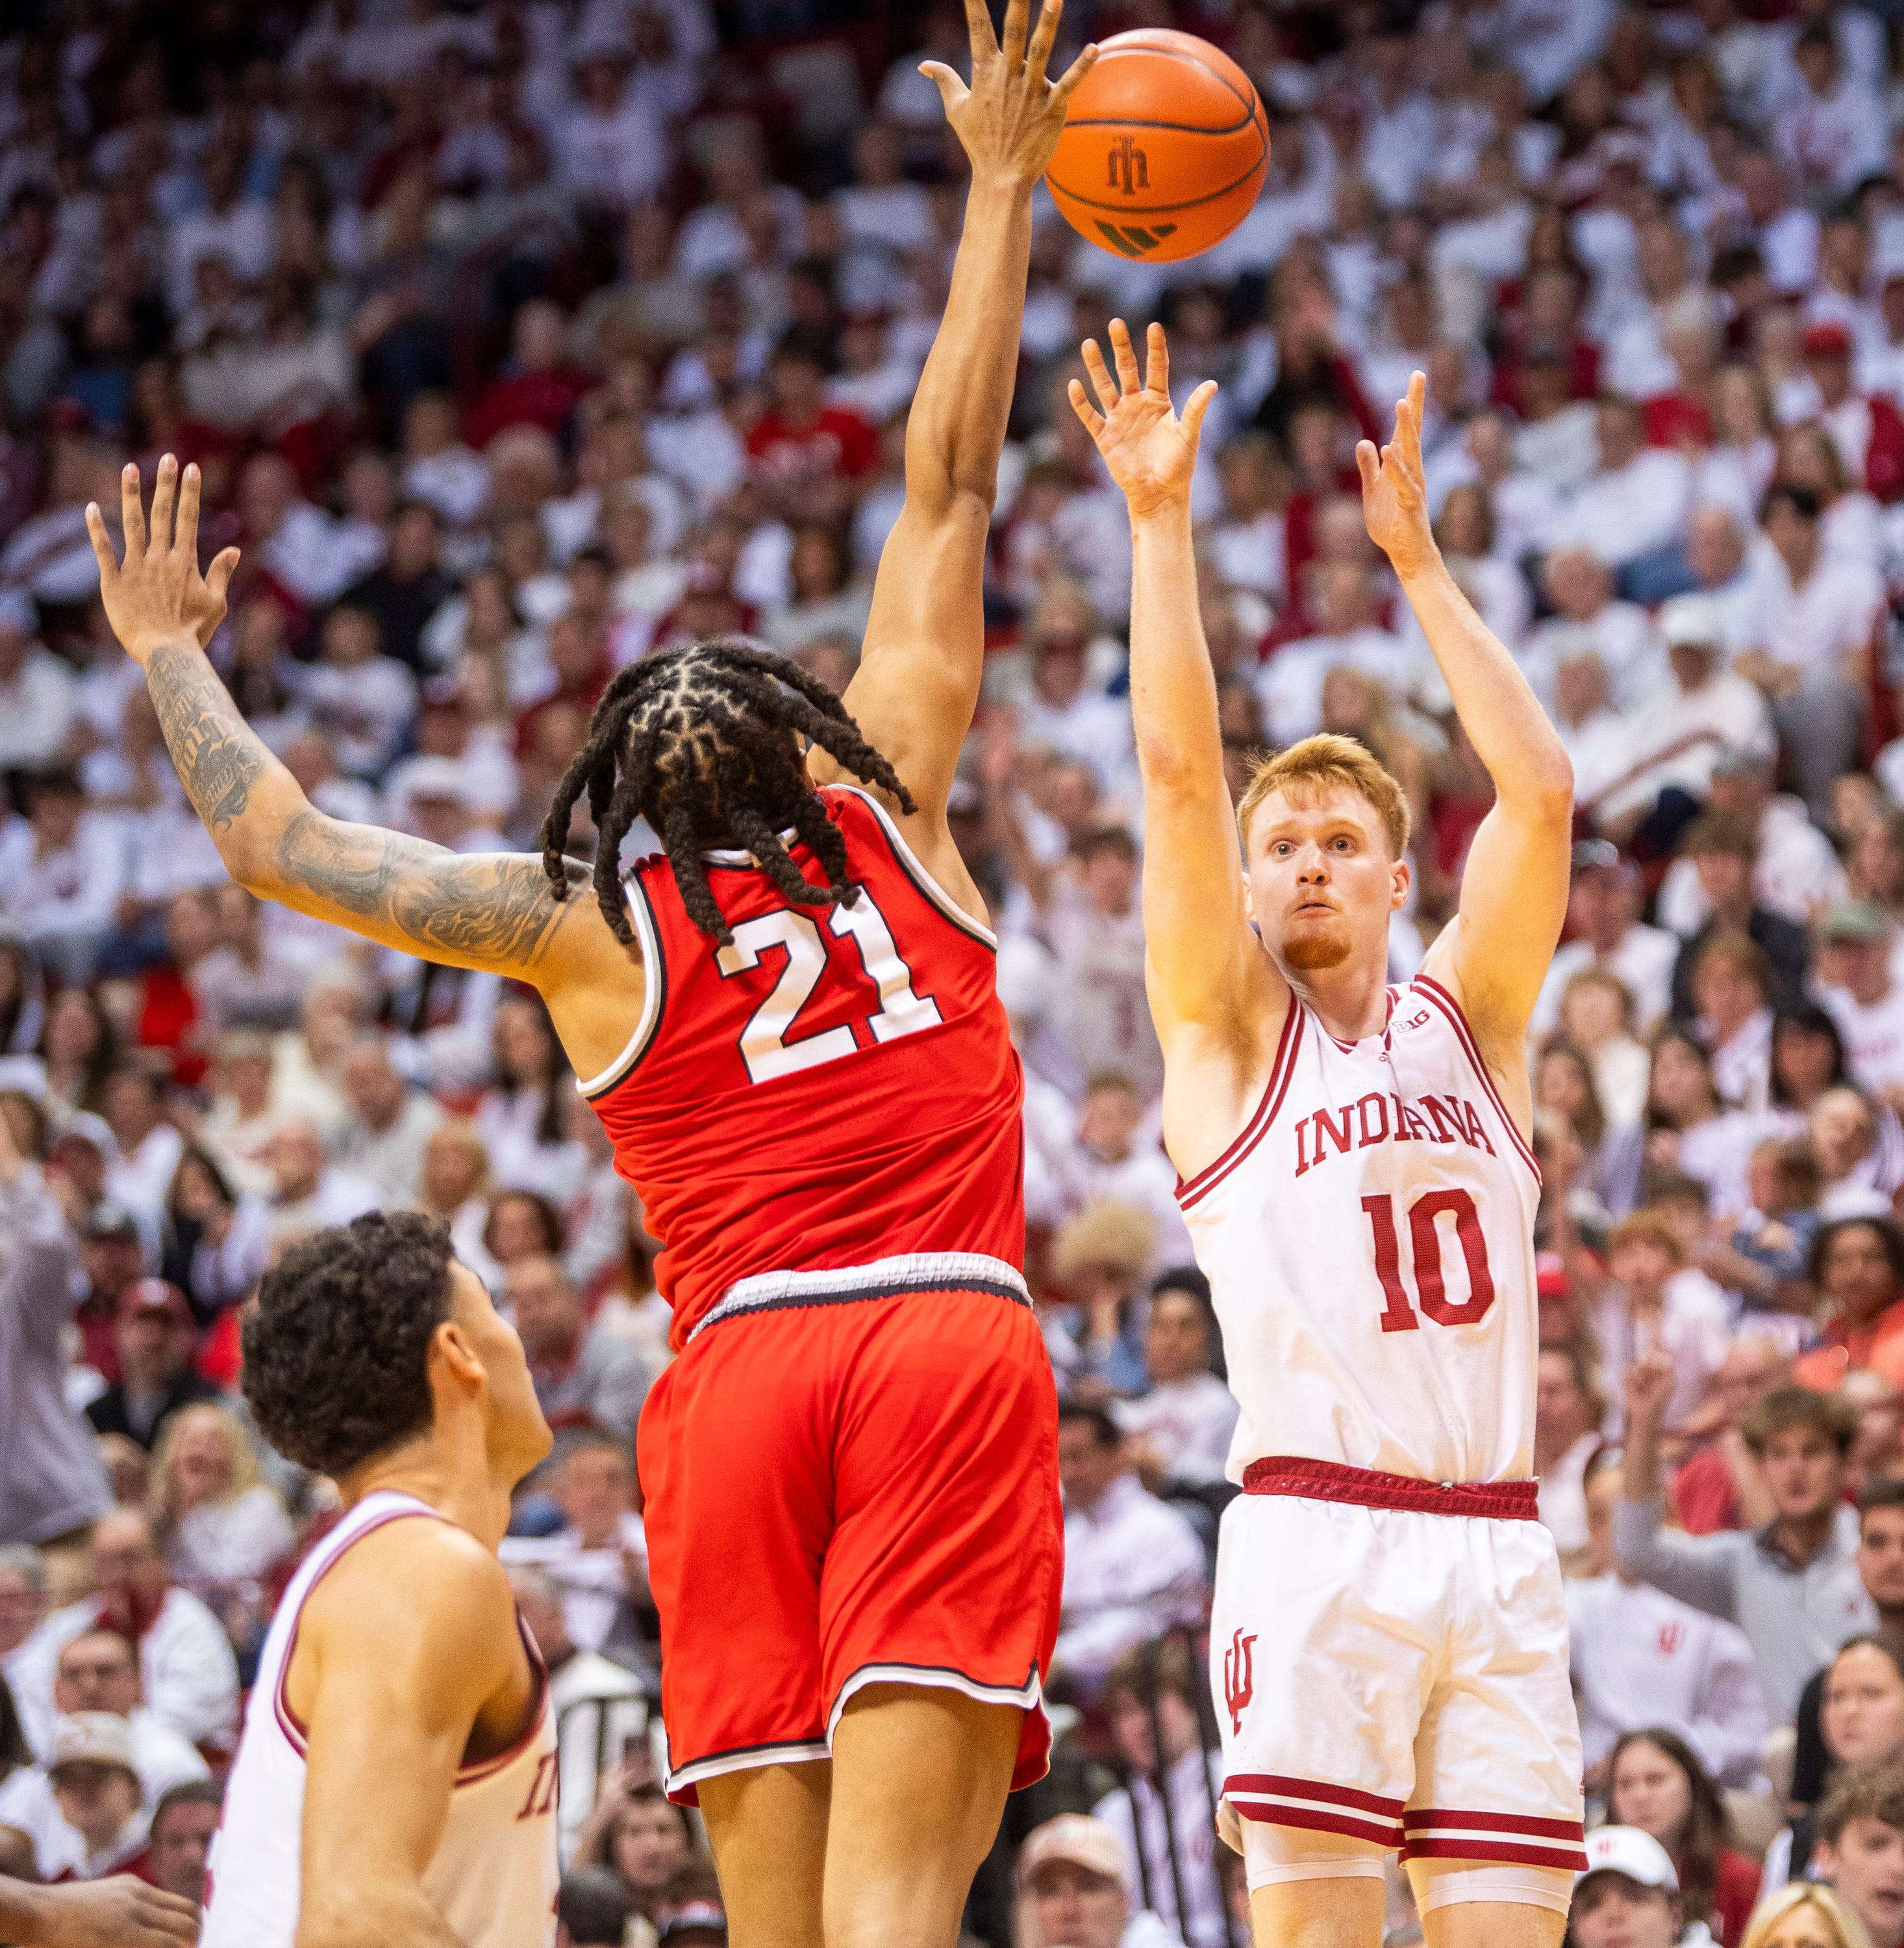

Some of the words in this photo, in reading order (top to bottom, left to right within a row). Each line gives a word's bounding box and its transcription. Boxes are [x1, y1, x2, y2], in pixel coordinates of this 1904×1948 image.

[713, 884, 944, 1085] 21
[1295, 1092, 1497, 1179] INDIANA
[1360, 1188, 1496, 1332] 10
